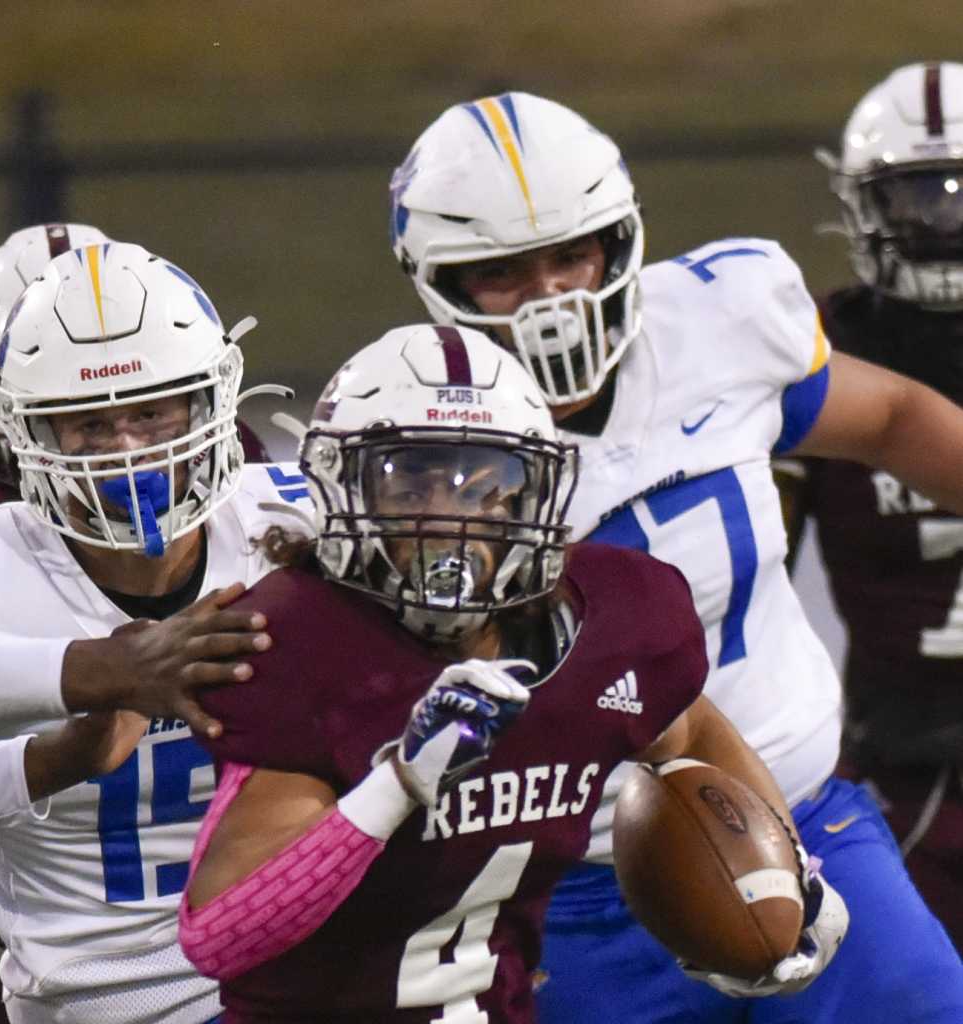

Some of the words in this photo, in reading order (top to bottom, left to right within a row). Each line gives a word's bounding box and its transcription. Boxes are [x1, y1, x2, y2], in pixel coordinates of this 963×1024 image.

[80, 360, 143, 381] Riddell
[436, 389, 474, 404] PLUS
[427, 408, 493, 424] Riddell
[596, 695, 643, 715] adidas
[422, 763, 600, 841] REBELS
